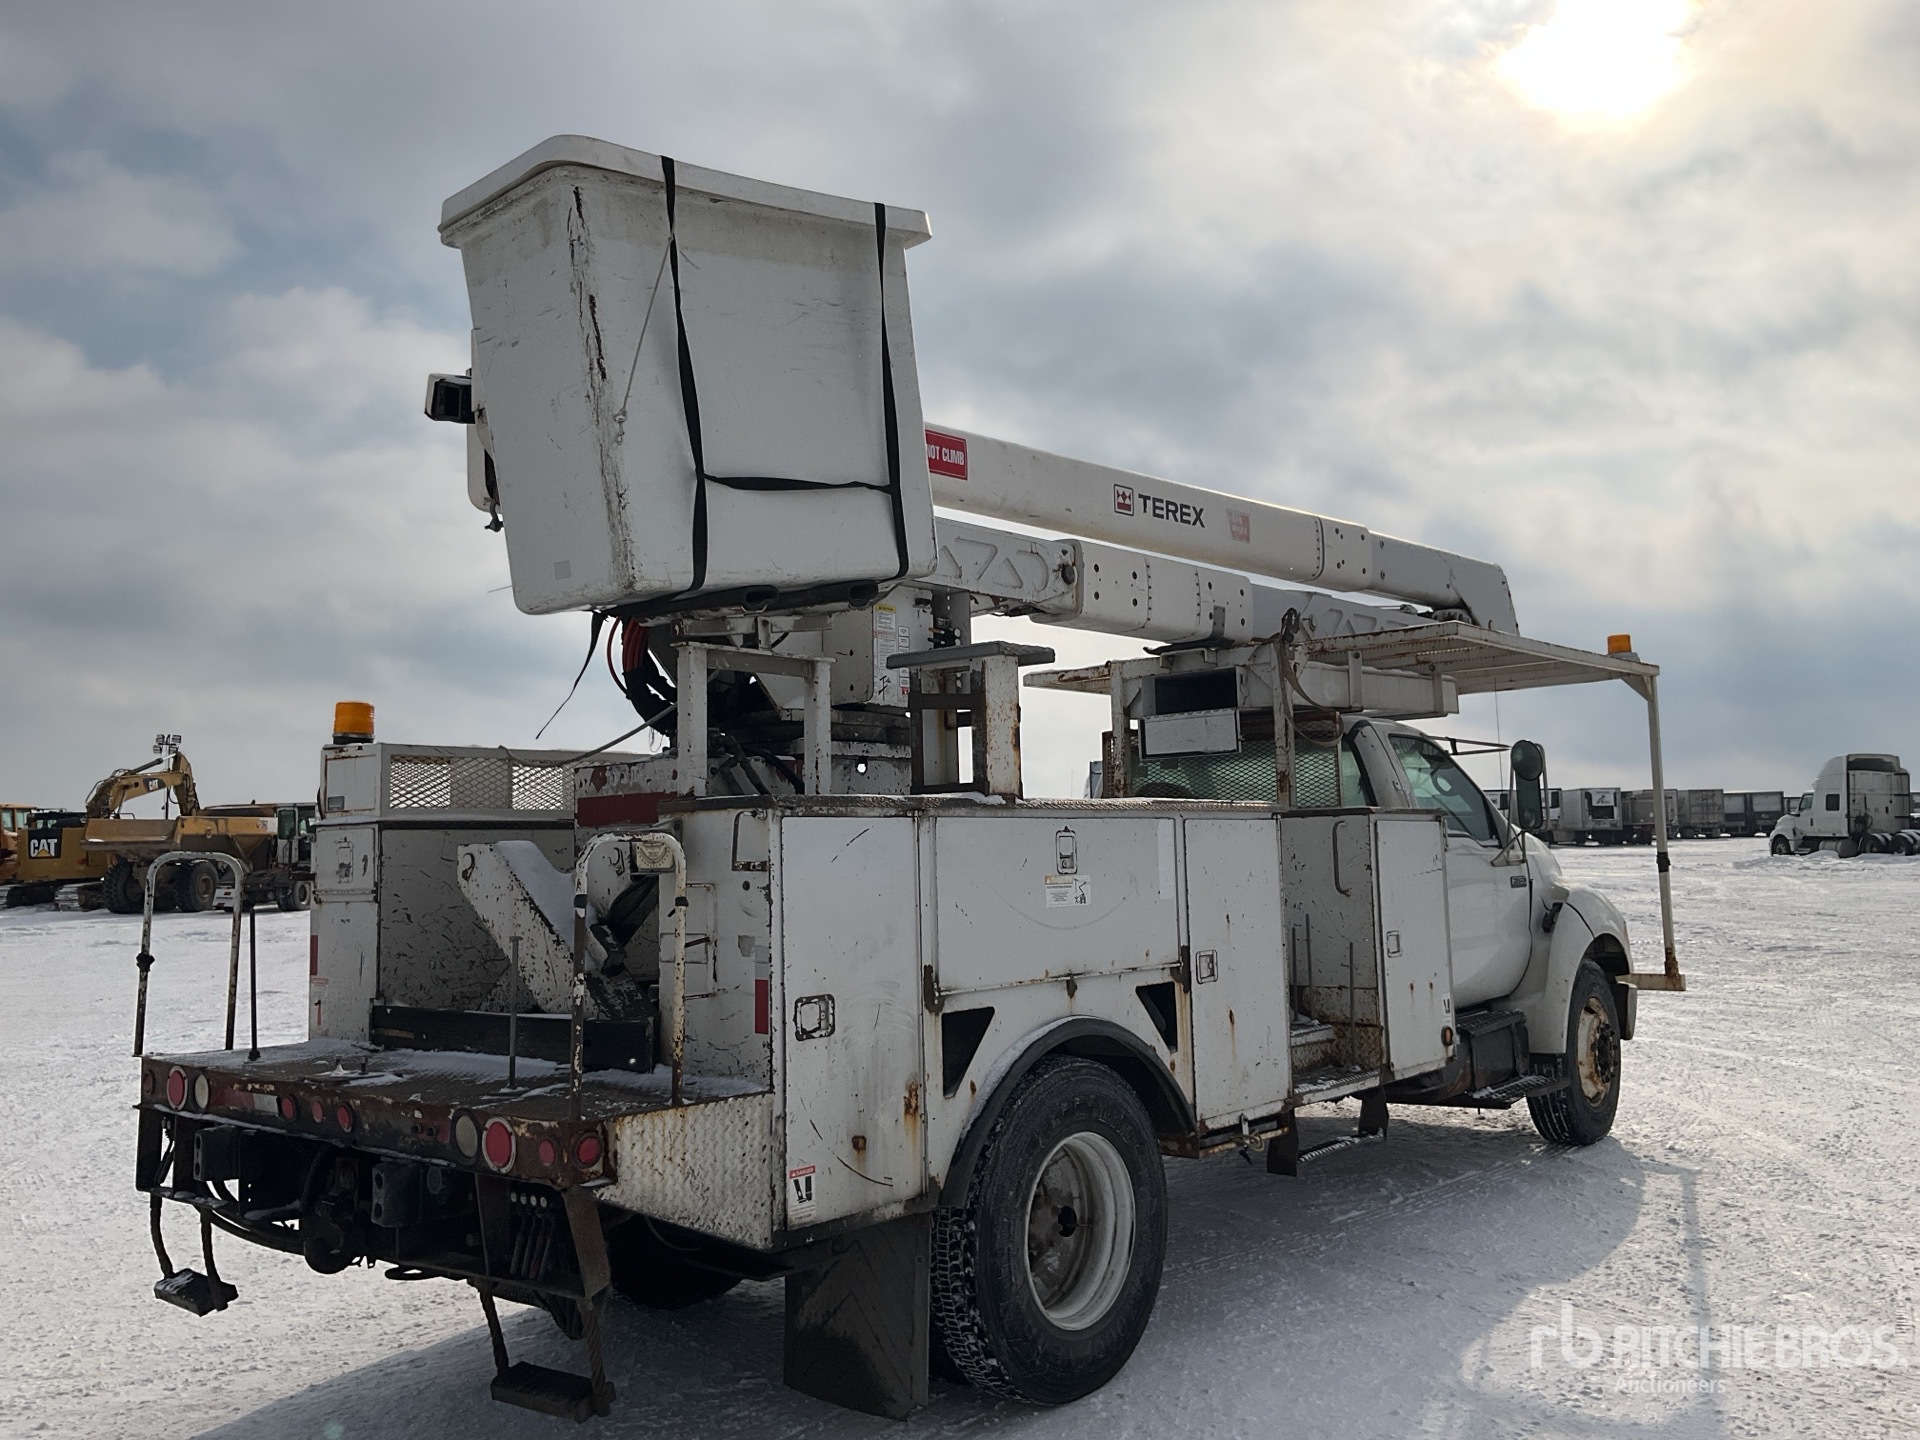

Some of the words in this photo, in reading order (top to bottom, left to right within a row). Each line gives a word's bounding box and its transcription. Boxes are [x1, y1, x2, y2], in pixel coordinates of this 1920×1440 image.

[942, 447, 965, 466] CLIMB
[1138, 493, 1205, 528] TEREX
[30, 838, 58, 857] CAT
